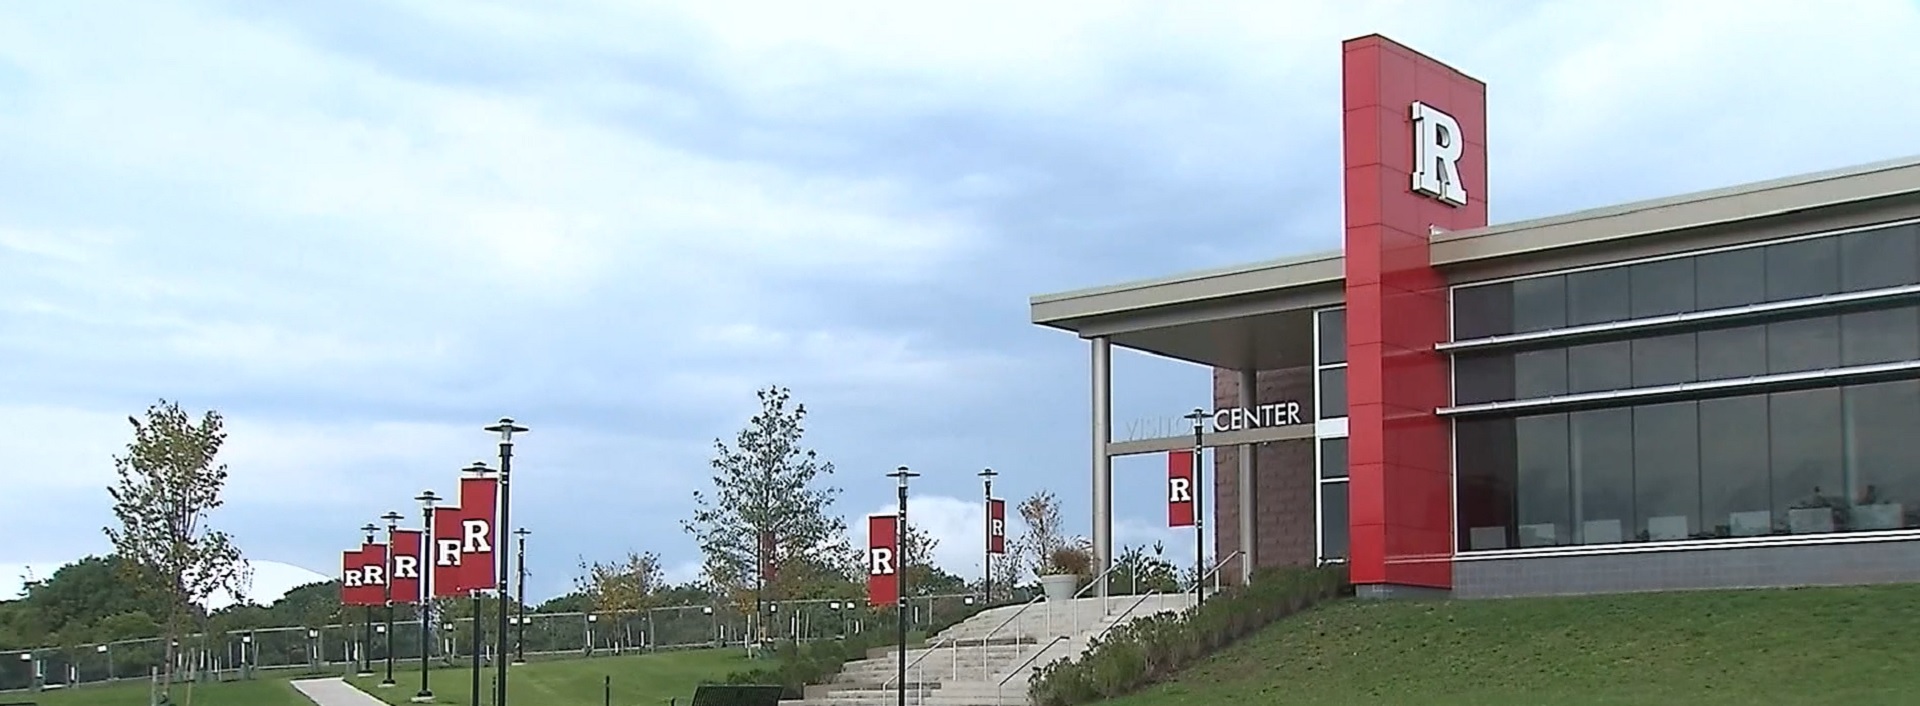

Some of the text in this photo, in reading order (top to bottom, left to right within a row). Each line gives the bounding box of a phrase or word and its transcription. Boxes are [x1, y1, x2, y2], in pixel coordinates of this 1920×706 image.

[1411, 100, 1468, 206] R
[1126, 402, 1301, 440] VISITO CENTER
[1169, 478, 1191, 502] R
[462, 520, 491, 552] R
[992, 519, 1003, 536] R
[437, 539, 460, 566] R
[871, 548, 894, 575] R
[345, 570, 361, 587] R
[364, 565, 384, 584] R
[394, 556, 418, 577] R
